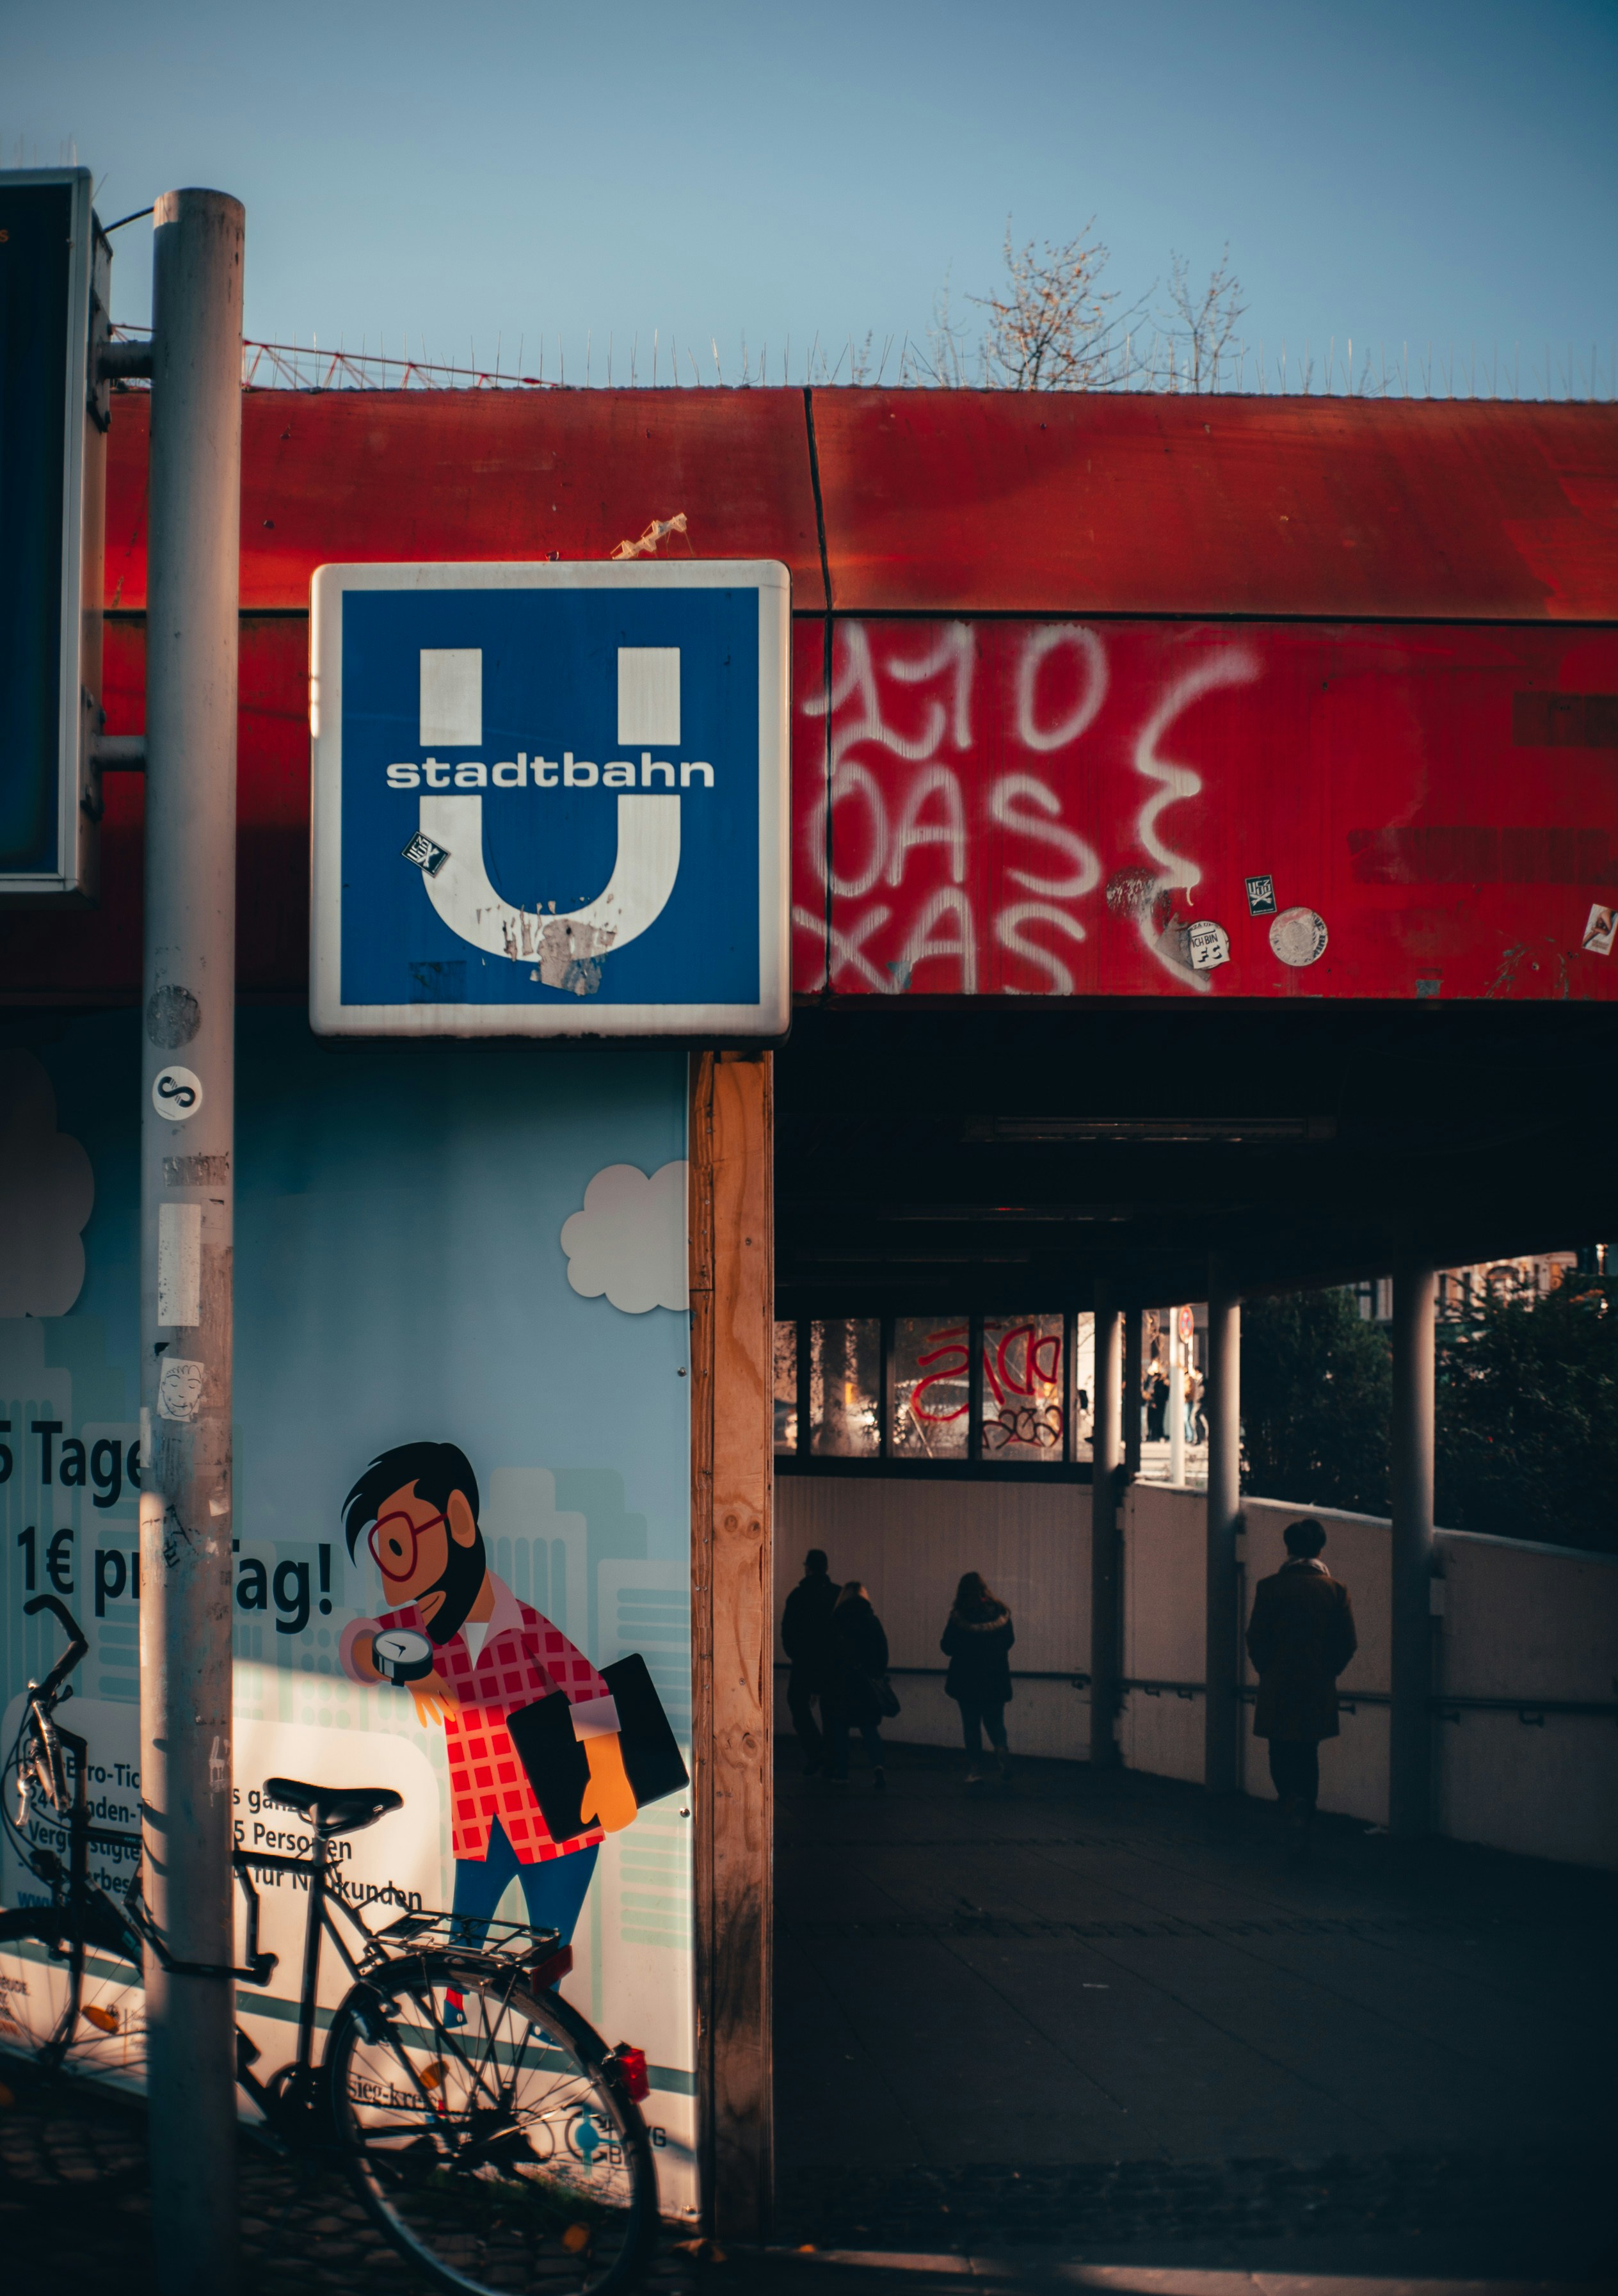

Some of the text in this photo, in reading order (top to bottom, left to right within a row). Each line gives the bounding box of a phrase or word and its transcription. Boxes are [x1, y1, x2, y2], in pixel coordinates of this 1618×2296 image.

[386, 751, 716, 789] stadtbahn
[420, 647, 681, 963] U
[1204, 933, 1219, 945] BIN
[17, 1526, 74, 1594] 1€
[232, 1539, 332, 1634] ag!
[234, 1820, 245, 1843] 5
[253, 1822, 352, 1859] Persoen
